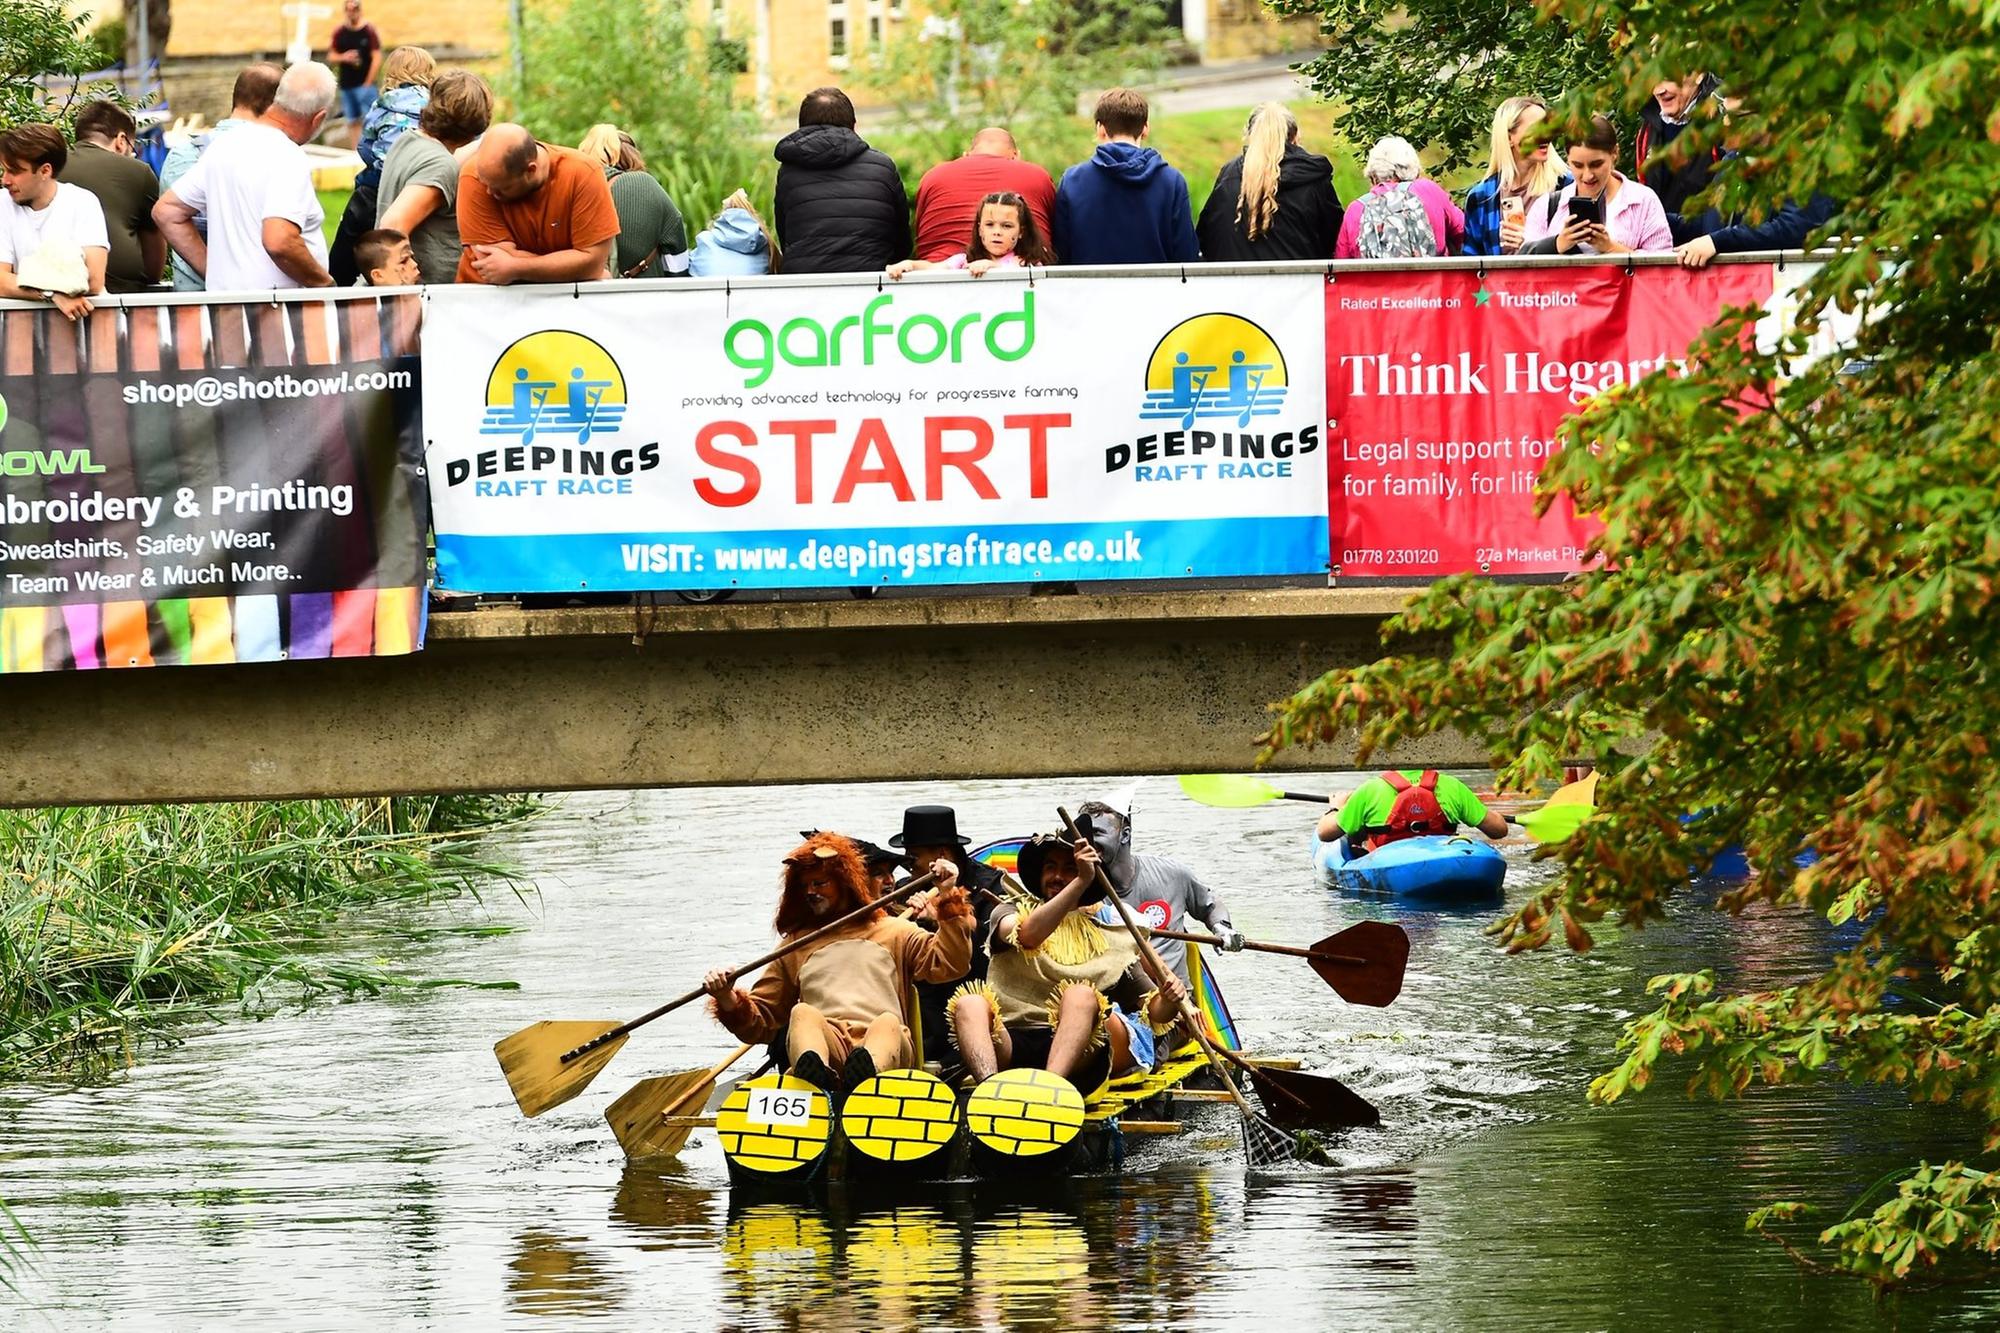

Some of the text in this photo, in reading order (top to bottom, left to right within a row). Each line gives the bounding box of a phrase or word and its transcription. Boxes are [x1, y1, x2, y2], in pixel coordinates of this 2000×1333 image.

[1340, 295, 1461, 310] Rated Excellent on
[1497, 291, 1577, 308] Trustpilot
[723, 290, 1035, 389] garford
[122, 370, 411, 406] shop@shotbowl.com
[1340, 351, 1490, 397] Think
[682, 386, 1079, 409] providing advanced technology for progressive farming
[0, 449, 107, 477] OWL
[446, 442, 660, 488] DEEPINGS
[692, 412, 1072, 508] START
[1105, 425, 1319, 474] DEEPINGS
[1343, 438, 1409, 466] Legal
[1416, 438, 1513, 466] support
[1520, 435, 1554, 458] for
[475, 478, 633, 497] RAFT RACE
[1135, 462, 1293, 482] RAFT RACE
[1343, 476, 1377, 497] for
[1383, 472, 1463, 500] family,
[1471, 472, 1504, 494] for
[173, 488, 201, 519] &
[212, 479, 354, 516] Printing
[0, 530, 276, 562] Sweatshirts, Safety Wear,
[621, 530, 1142, 578] VISIT: www.deepingsraftrace.co.uk
[1343, 548, 1439, 565] 01778 230120
[1475, 545, 1608, 563] 27a Market Plae,
[6, 561, 302, 594] Team Wear & Much More..
[758, 1097, 806, 1117] 165
